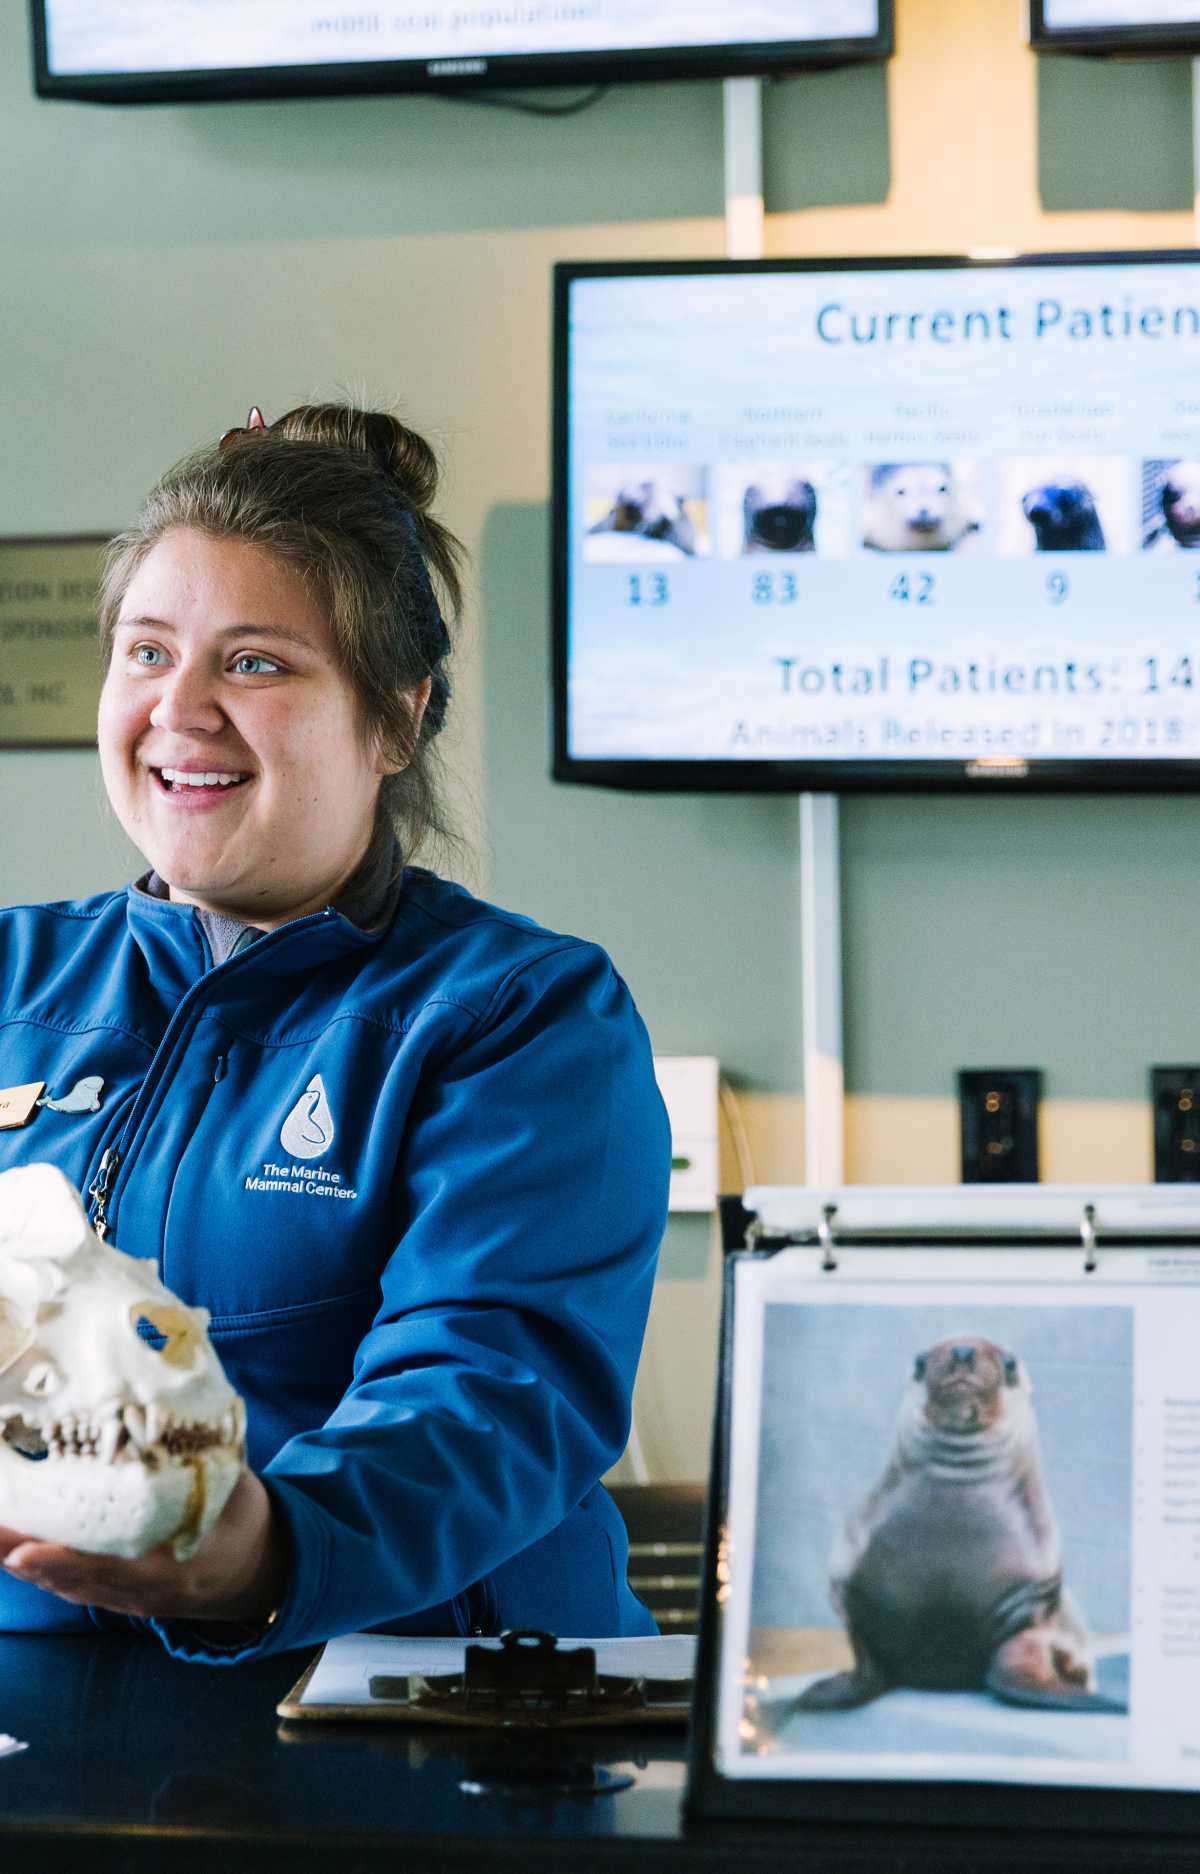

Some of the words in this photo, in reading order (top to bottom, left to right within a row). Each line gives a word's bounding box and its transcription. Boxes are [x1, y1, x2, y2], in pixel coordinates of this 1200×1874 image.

[815, 301, 1013, 345] Current
[1035, 298, 1200, 339] Patien
[625, 572, 671, 606] 13
[751, 572, 799, 605] 83
[890, 572, 937, 604] 42
[1045, 571, 1071, 604] 9
[773, 657, 890, 694] Total
[907, 657, 1120, 694] Patients:
[1143, 656, 1194, 692] 14
[730, 719, 867, 746] Animals
[880, 717, 1039, 746] Released
[1052, 718, 1087, 744] in
[245, 1177, 304, 1193] Mammal
[263, 1164, 289, 1177] The
[291, 1165, 341, 1183] Marine
